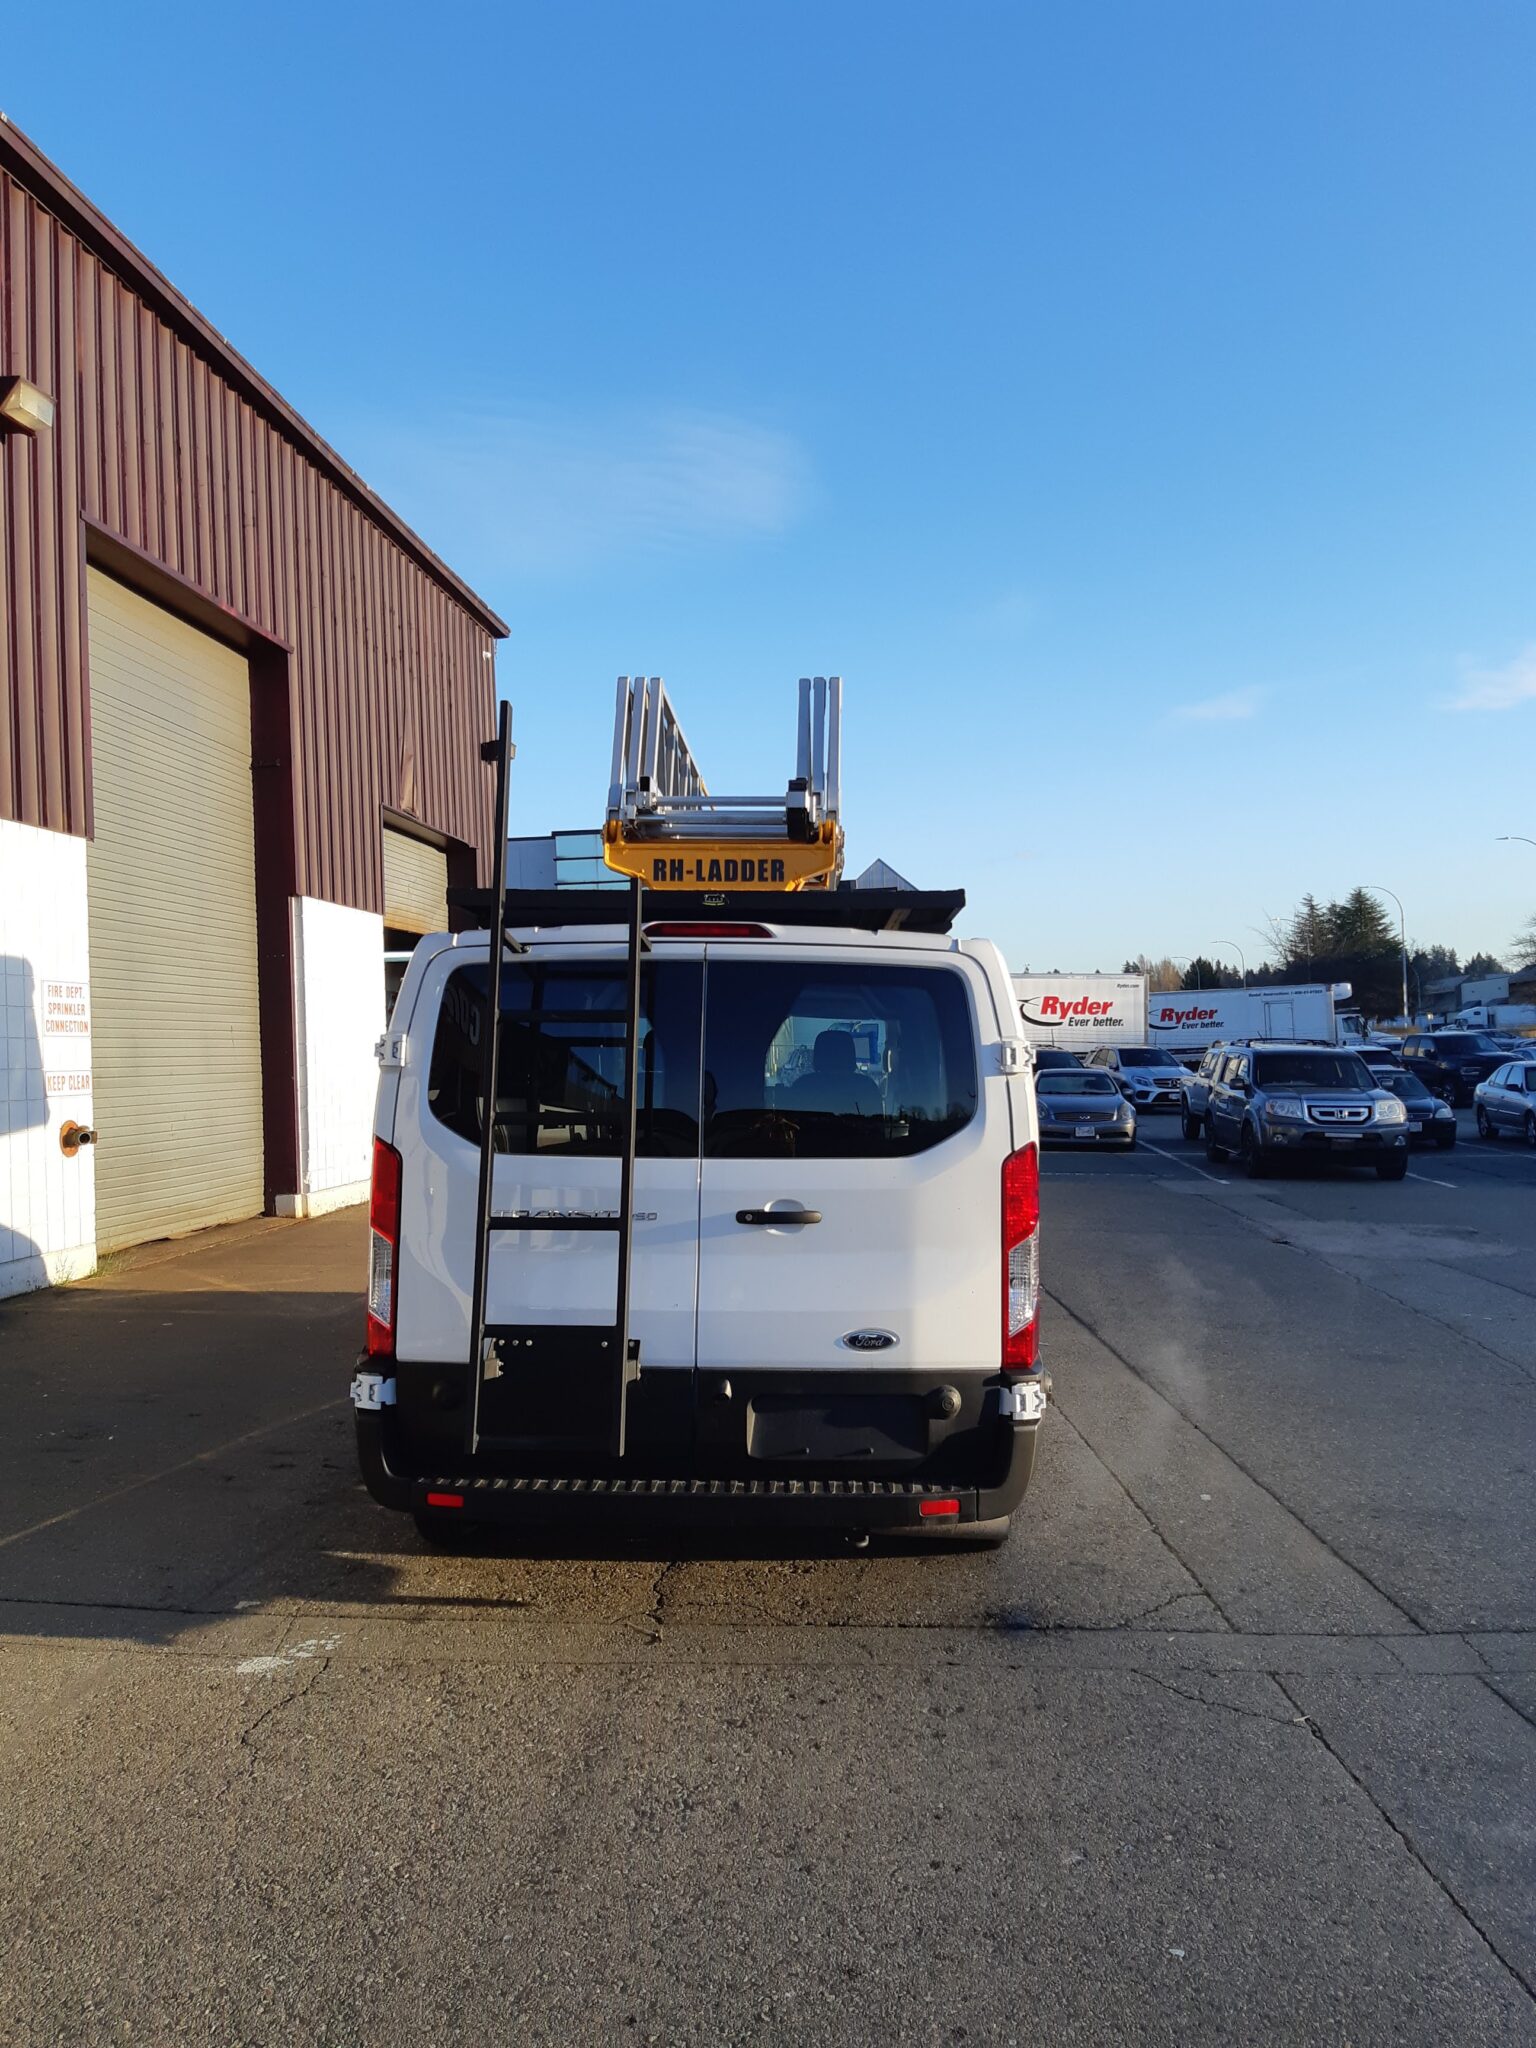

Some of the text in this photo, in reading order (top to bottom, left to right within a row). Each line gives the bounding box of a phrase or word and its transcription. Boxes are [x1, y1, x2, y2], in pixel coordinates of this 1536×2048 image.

[653, 858, 785, 882] RH-LADDER
[48, 985, 86, 999] FIRE DEPT.
[48, 1003, 86, 1016] SPRINKLER
[1040, 996, 1114, 1020] Ryder
[1068, 1016, 1125, 1028] Ever better.
[1160, 1007, 1218, 1025] Ryder
[46, 1020, 89, 1033] CONNECTION
[1181, 1020, 1225, 1030] Ever better.
[47, 1075, 90, 1092] KEEP CLEAR
[856, 1334, 884, 1347] Ford
